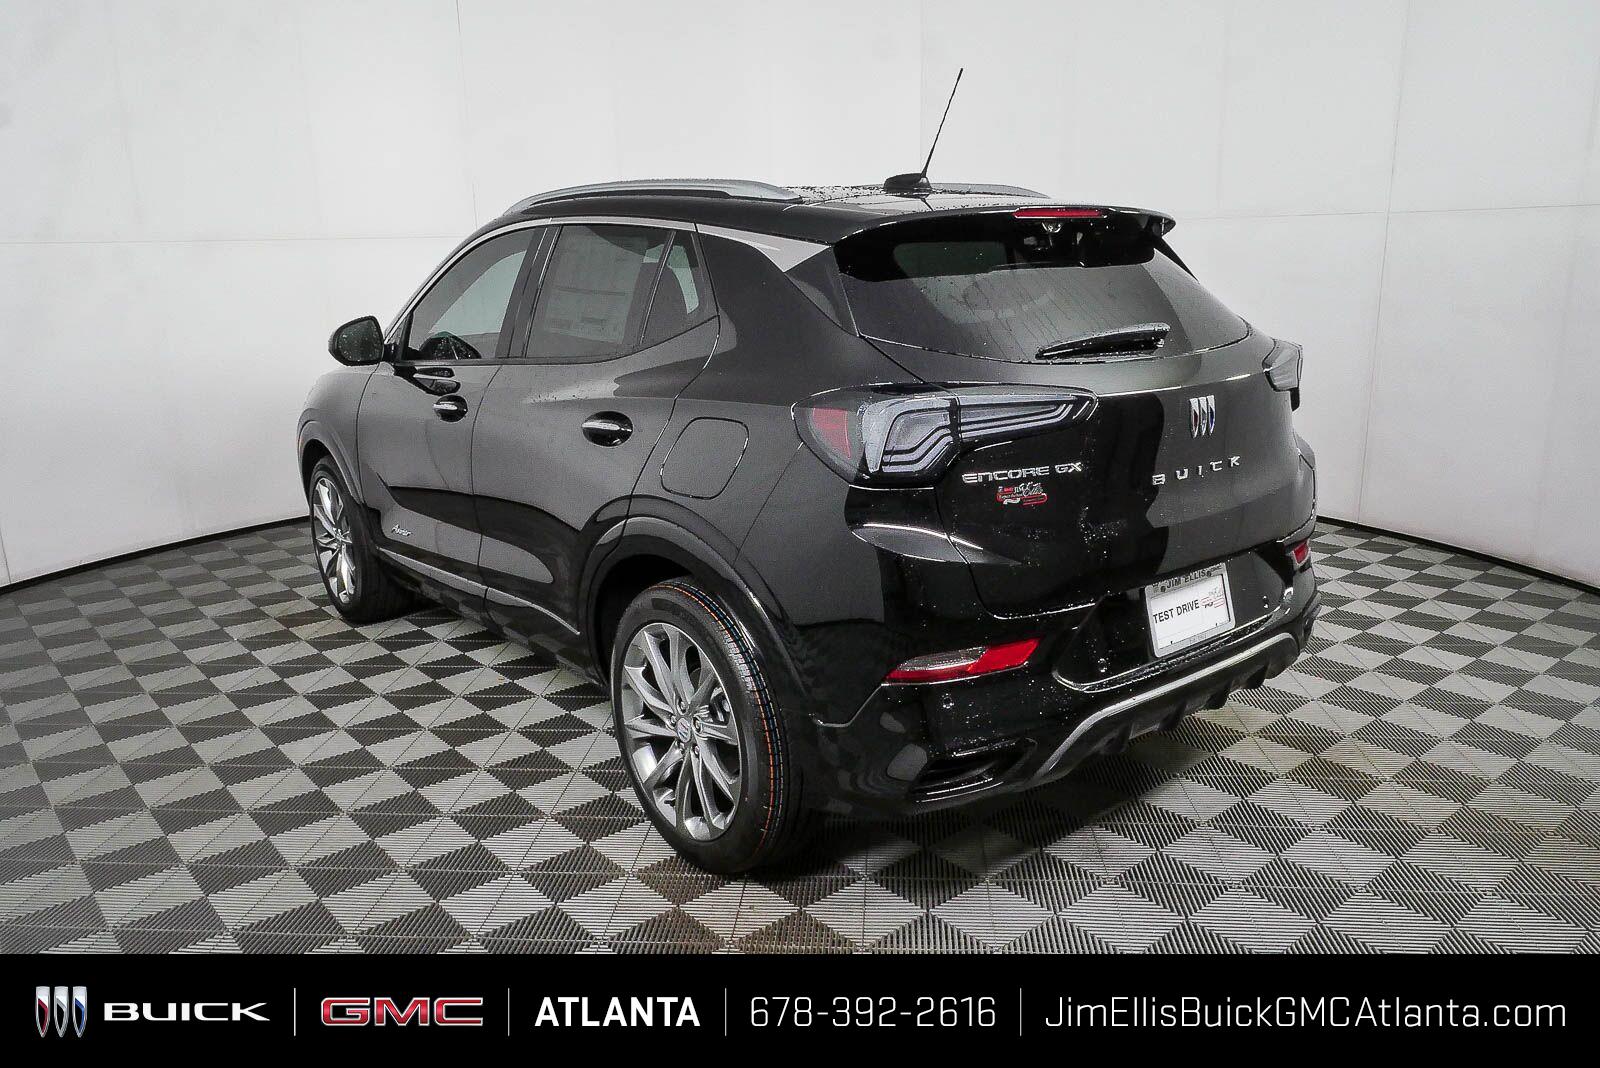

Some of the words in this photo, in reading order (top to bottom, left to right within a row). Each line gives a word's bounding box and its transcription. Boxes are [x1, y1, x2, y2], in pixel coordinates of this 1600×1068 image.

[962, 465, 1050, 484] ENCORE
[1054, 461, 1083, 474] GX
[1151, 455, 1241, 485] BUICK
[1166, 577, 1181, 589] JIM
[1184, 569, 1206, 584] ELLIS
[1153, 608, 1174, 624] TEST
[1176, 599, 1200, 616] DRIVE
